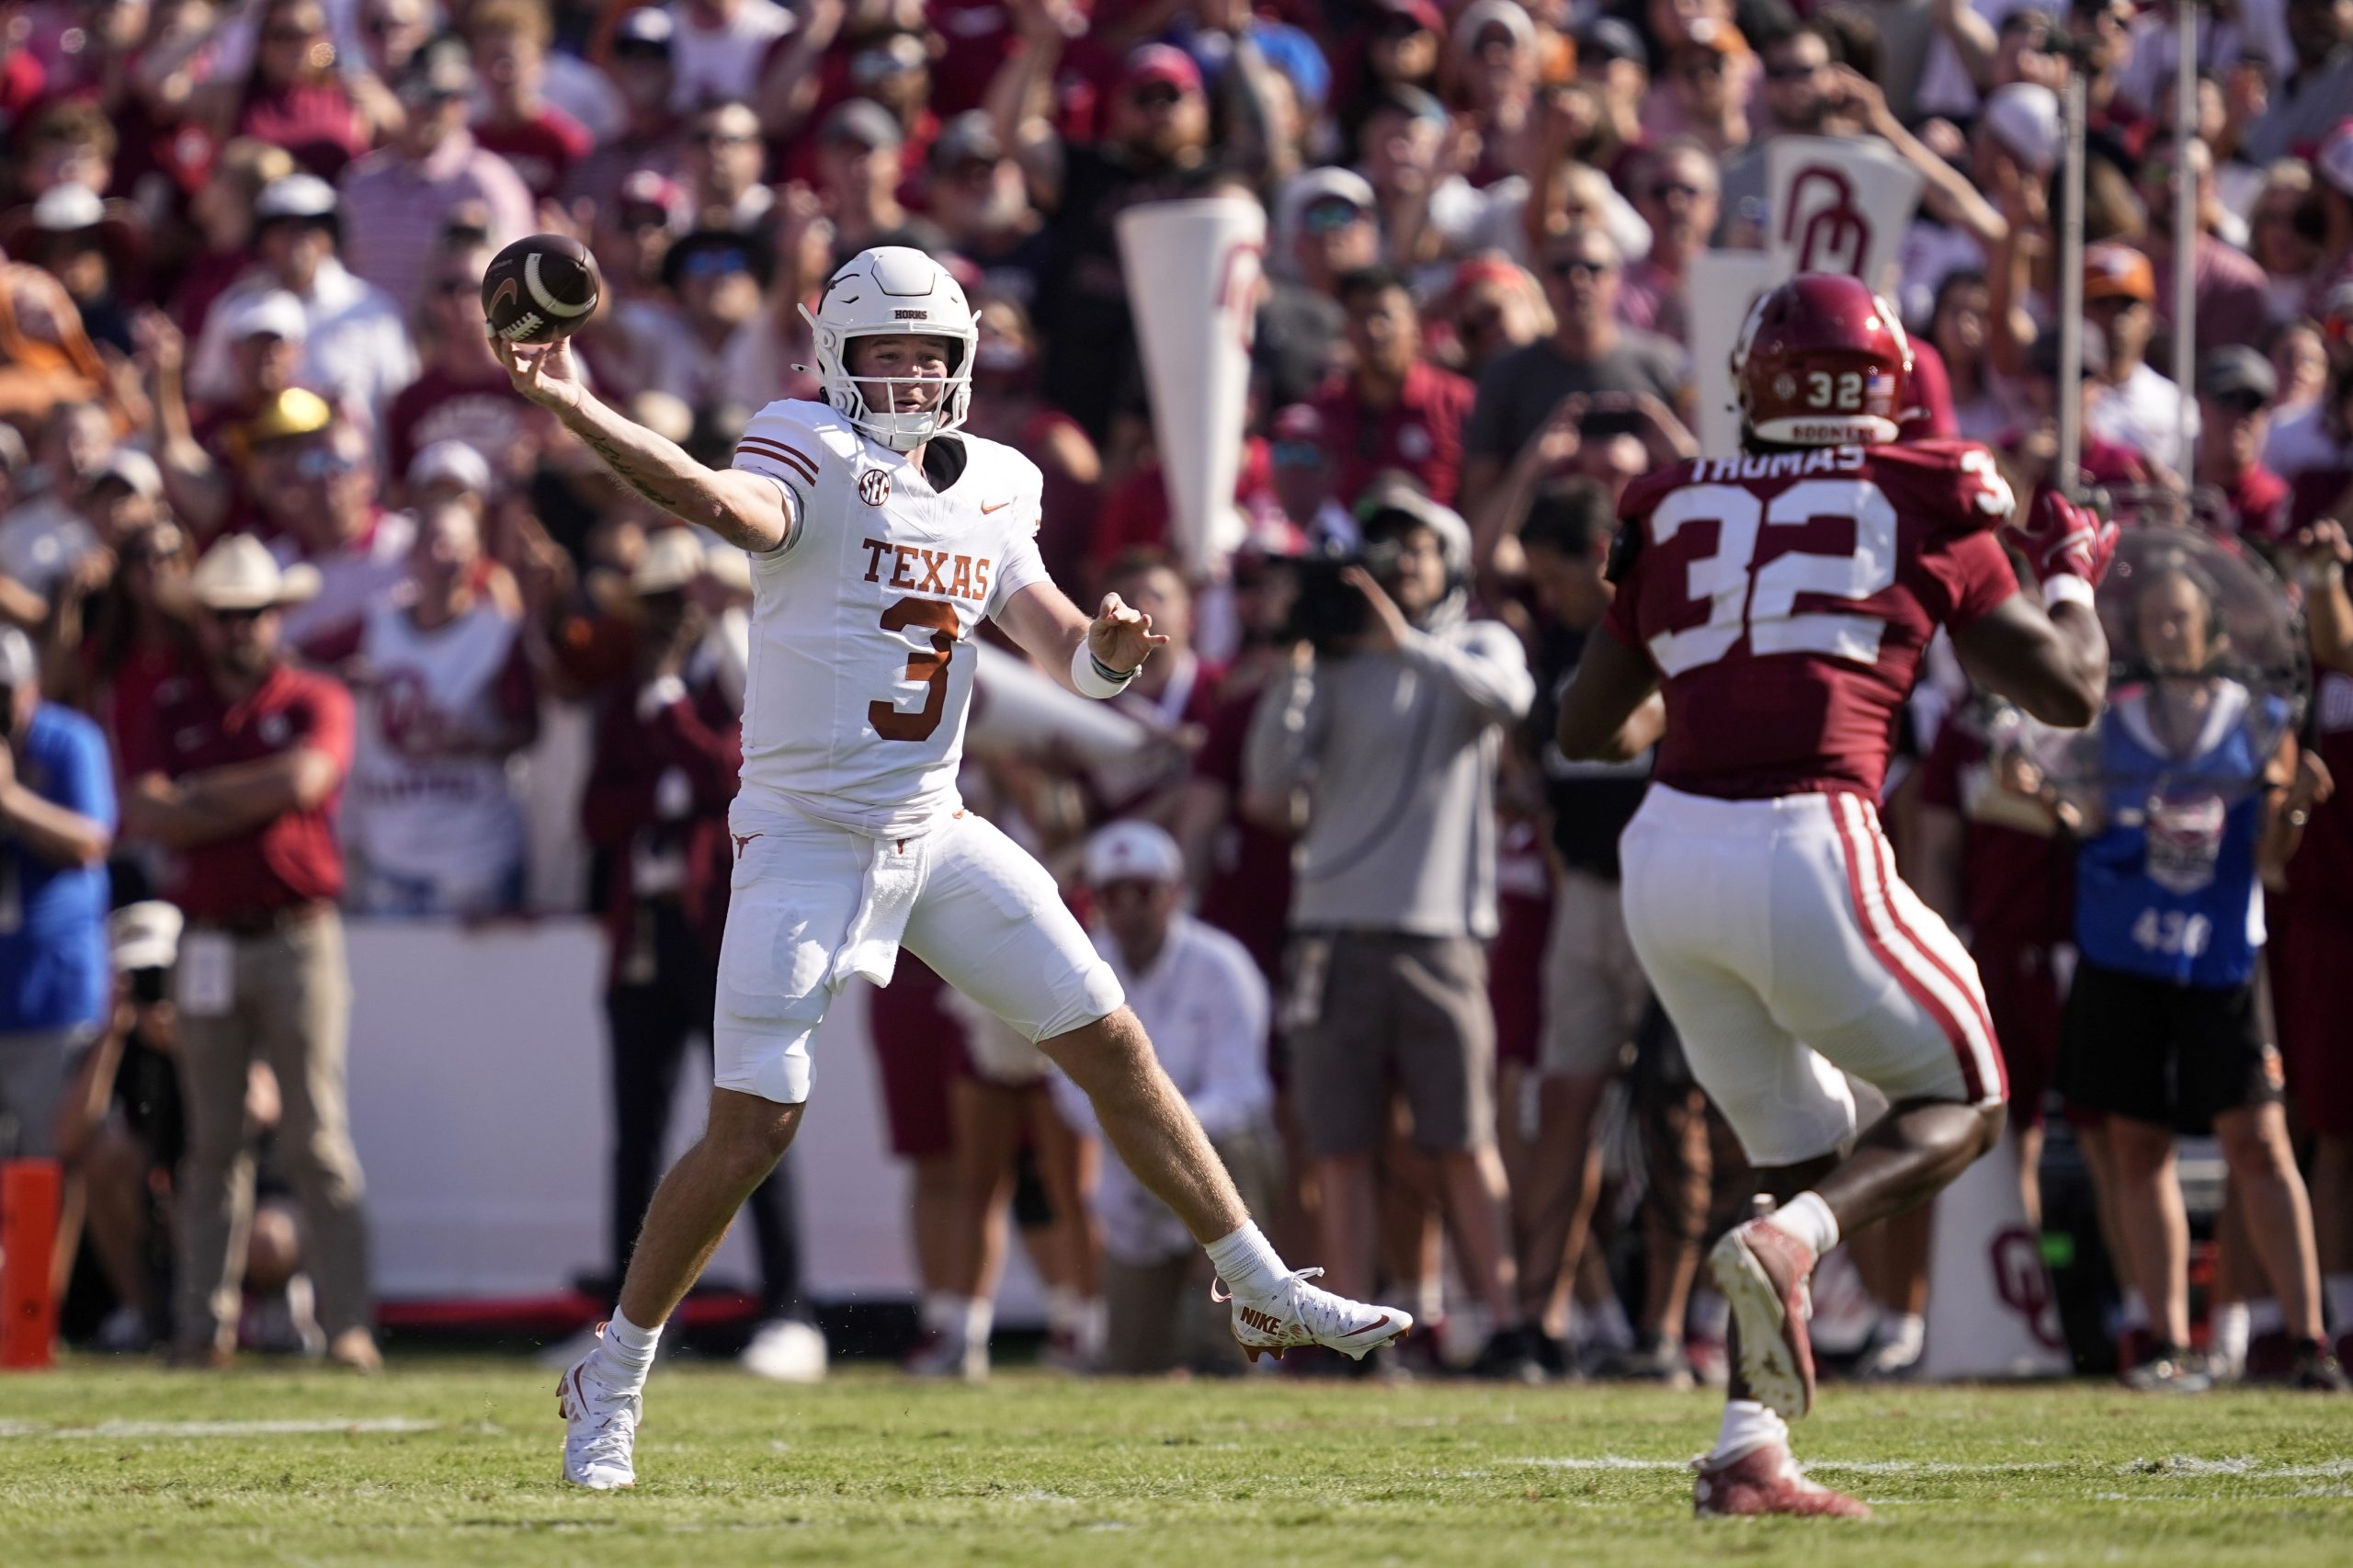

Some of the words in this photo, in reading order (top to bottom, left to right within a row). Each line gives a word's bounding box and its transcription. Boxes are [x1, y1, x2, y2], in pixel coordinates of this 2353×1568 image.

[894, 310, 927, 319] HORNS
[1807, 370, 1863, 409] 32
[1691, 445, 1866, 483] THOMAS
[859, 469, 891, 506] SEC
[862, 538, 990, 600] TEXAS
[1648, 479, 1898, 678] 32
[868, 597, 960, 742] 3
[1240, 1306, 1282, 1336] NIKE
